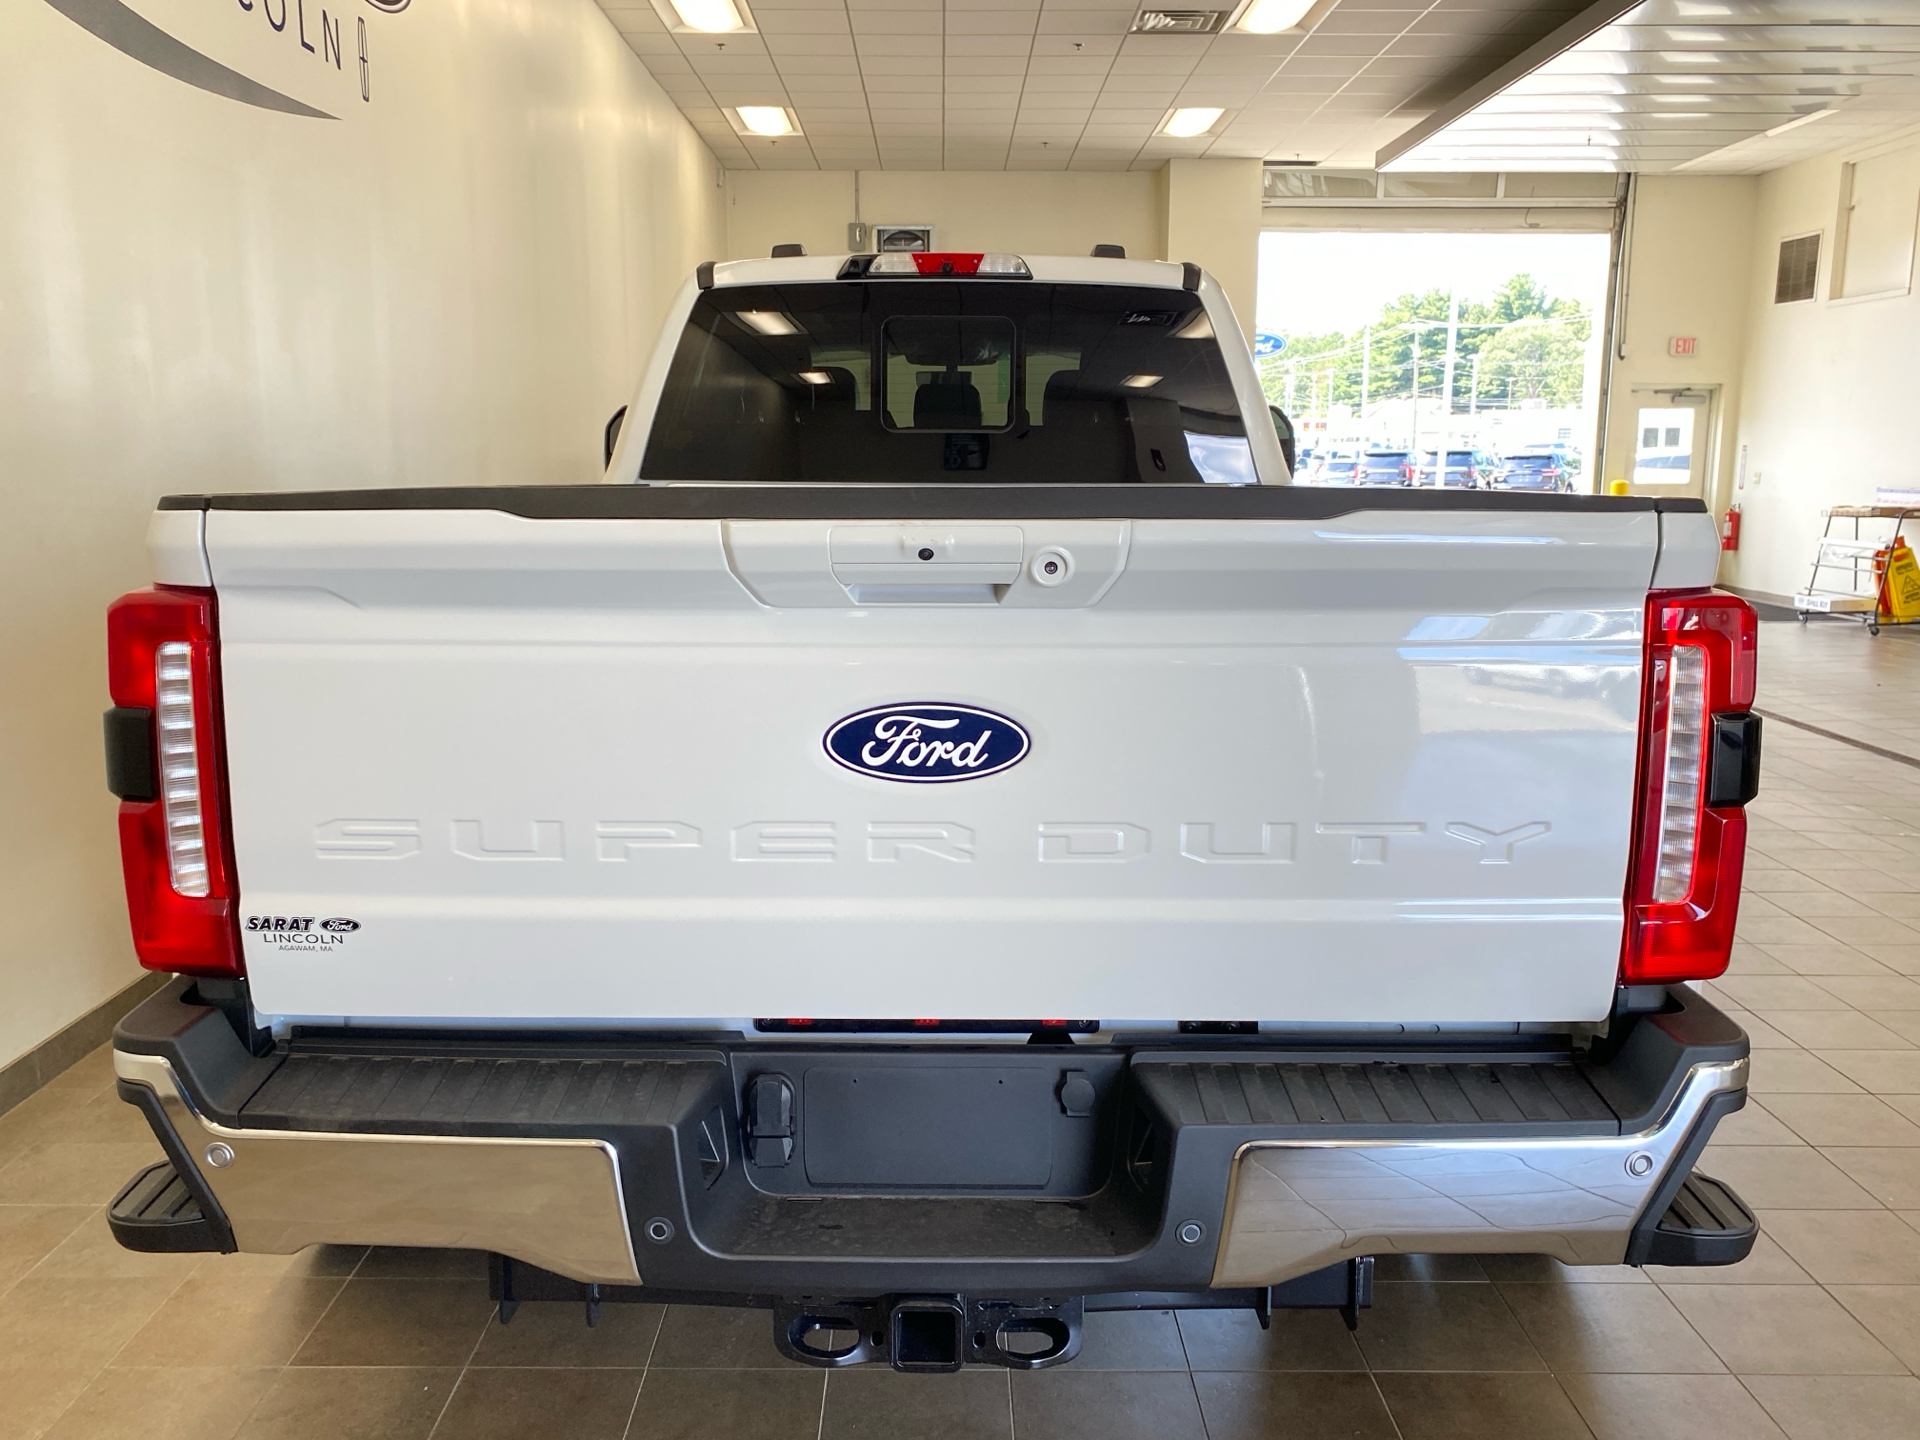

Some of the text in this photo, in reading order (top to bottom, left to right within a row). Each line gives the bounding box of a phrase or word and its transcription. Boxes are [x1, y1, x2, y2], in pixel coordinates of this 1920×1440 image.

[238, 0, 341, 70] OLN
[1675, 337, 1697, 354] EXIT
[861, 715, 992, 768] Ford
[315, 819, 1552, 864] SUPER DUTY
[246, 916, 354, 932] SARAT Ford
[263, 933, 344, 944] LINCOLN
[279, 945, 318, 953] AGAWAM,
